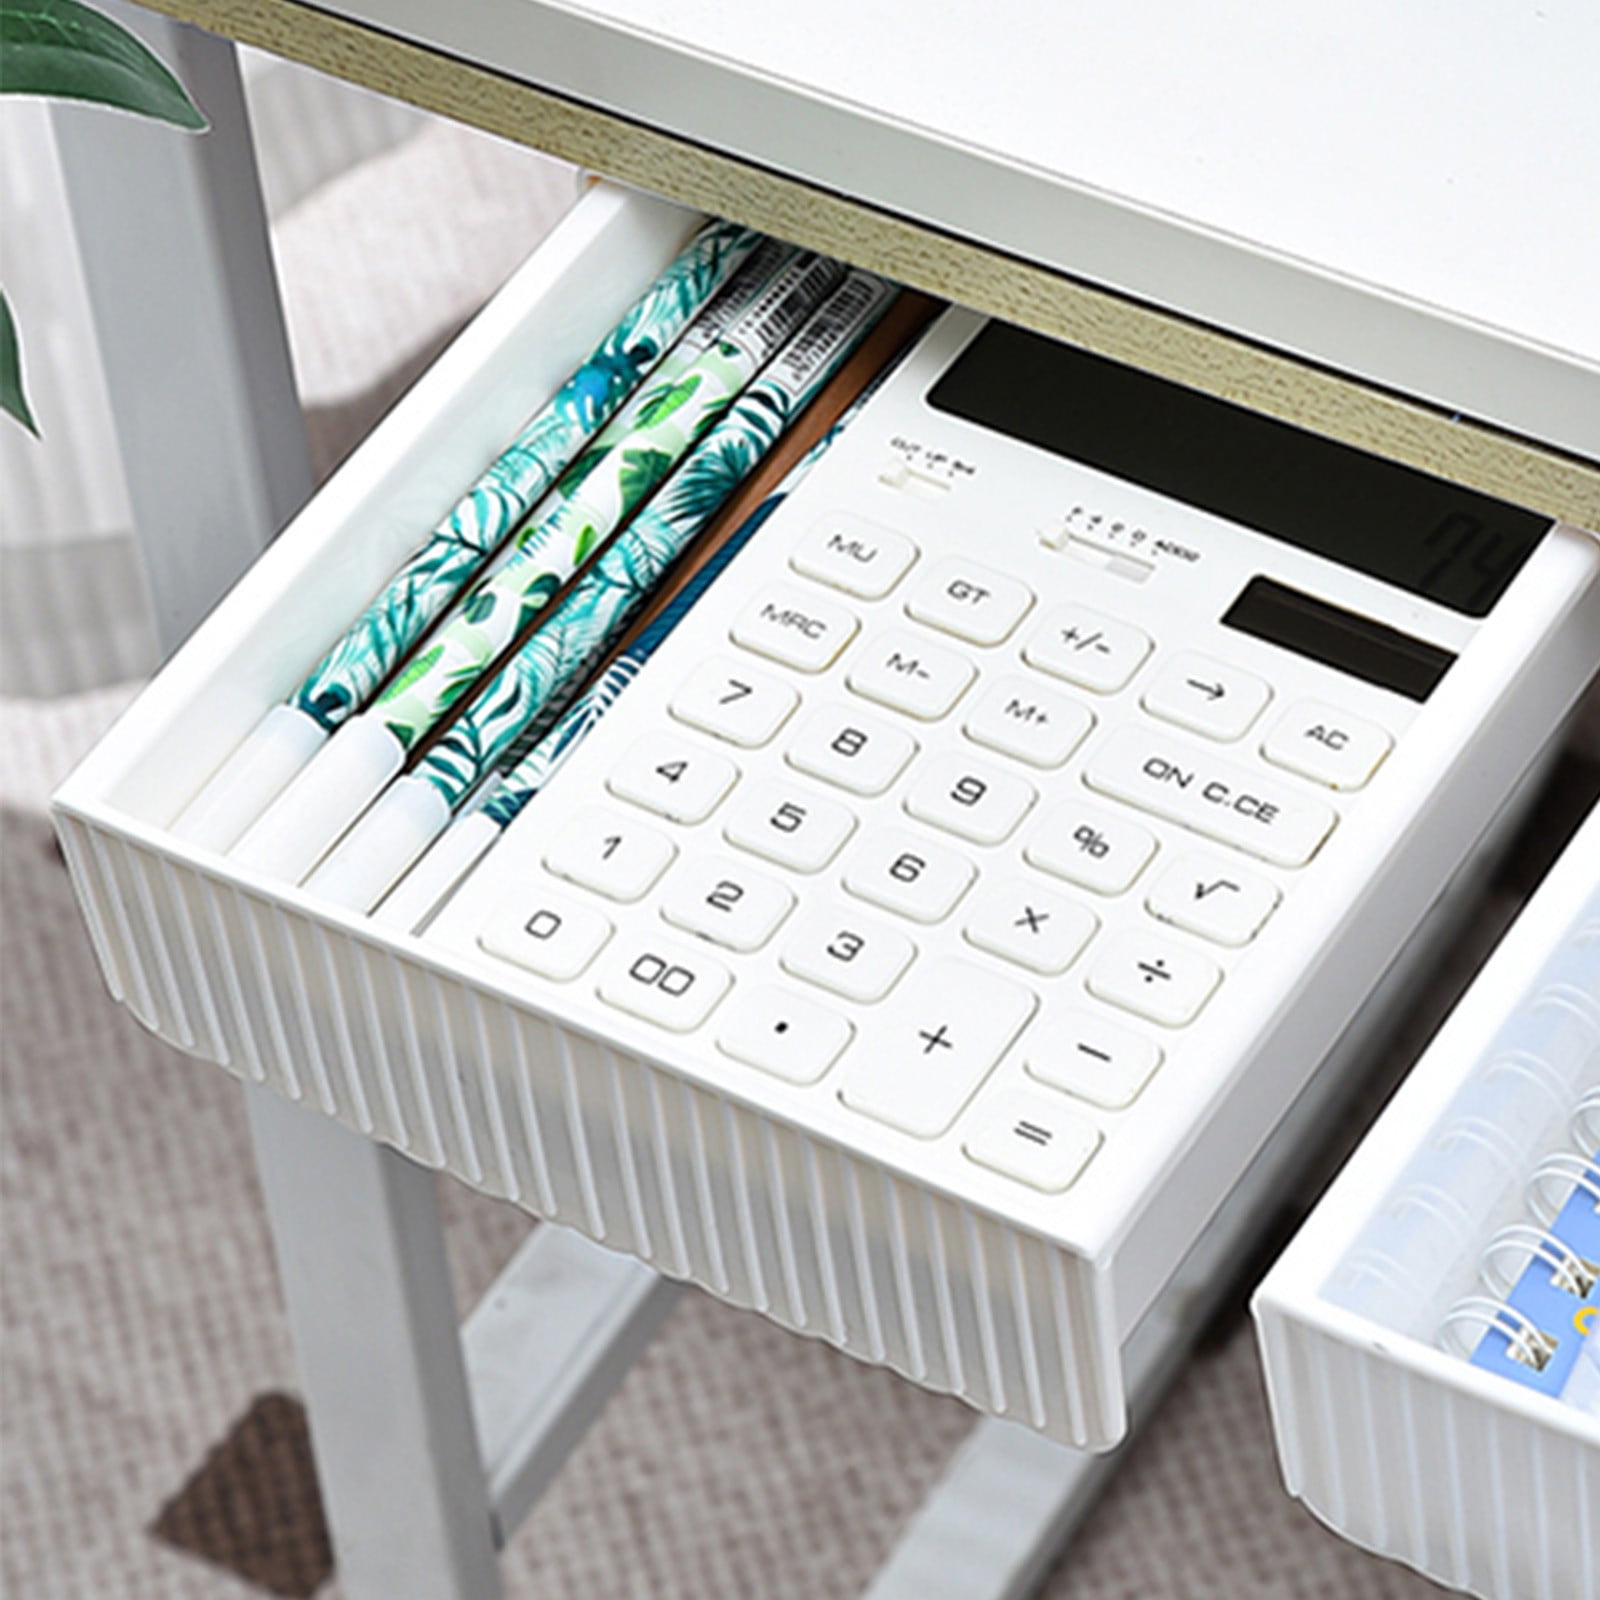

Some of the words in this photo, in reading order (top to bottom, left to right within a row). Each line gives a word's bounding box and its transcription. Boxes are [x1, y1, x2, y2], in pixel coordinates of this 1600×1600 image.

[828, 534, 877, 563] MU
[947, 580, 990, 604] GT
[761, 603, 826, 639] MRC
[719, 679, 753, 705] 7
[830, 727, 868, 758] 8
[1305, 725, 1349, 751] AC
[655, 761, 689, 783] 4
[949, 776, 988, 807] 9
[1142, 757, 1194, 789] ON
[1202, 781, 1279, 824] C.CE
[769, 802, 807, 833] 5
[602, 836, 622, 860] 1
[1073, 825, 1110, 859] %
[888, 853, 927, 883] 6
[705, 880, 745, 913] 2
[826, 931, 865, 963] 3
